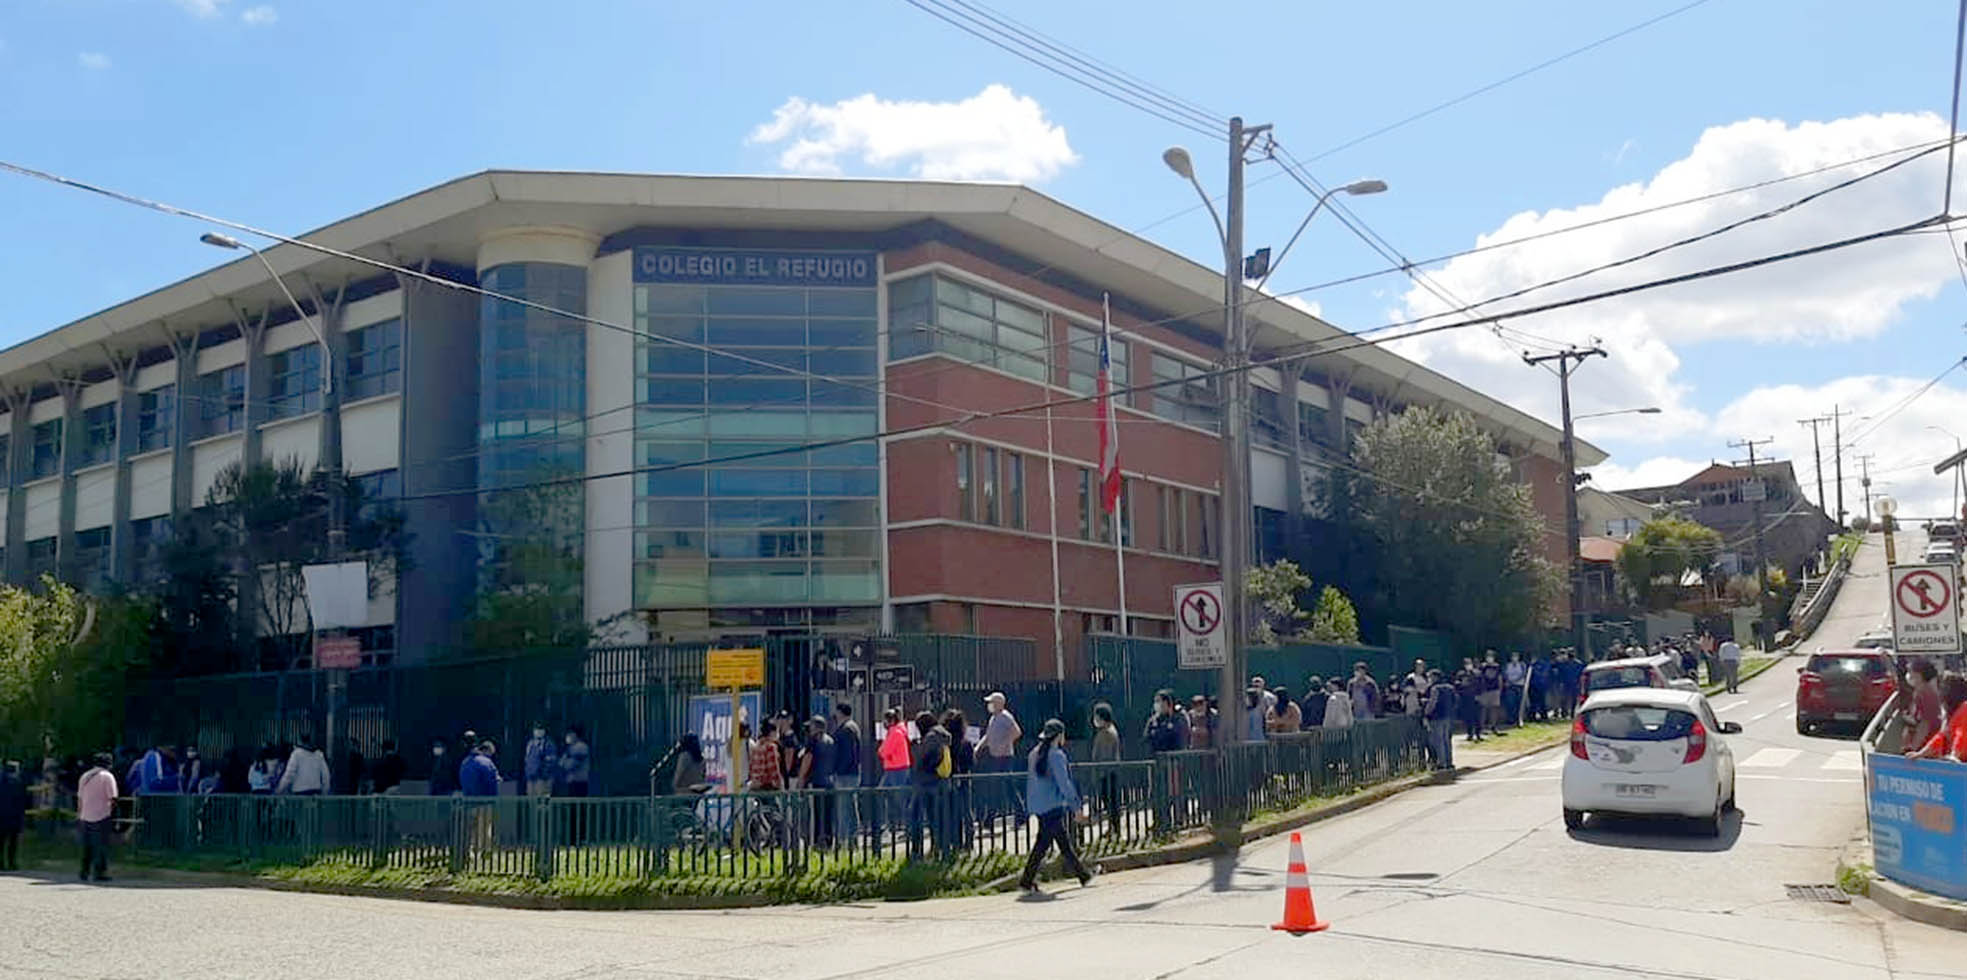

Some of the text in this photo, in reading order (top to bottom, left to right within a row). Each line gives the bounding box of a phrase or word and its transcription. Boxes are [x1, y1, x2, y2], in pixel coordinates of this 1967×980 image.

[642, 254, 868, 279] COLEGIO EL REFUGIO
[1904, 623, 1950, 632] BUSES Y
[1900, 637, 1955, 645] CAMIONES
[1889, 776, 1930, 799] PERMISO
[1931, 782, 1945, 802] DE
